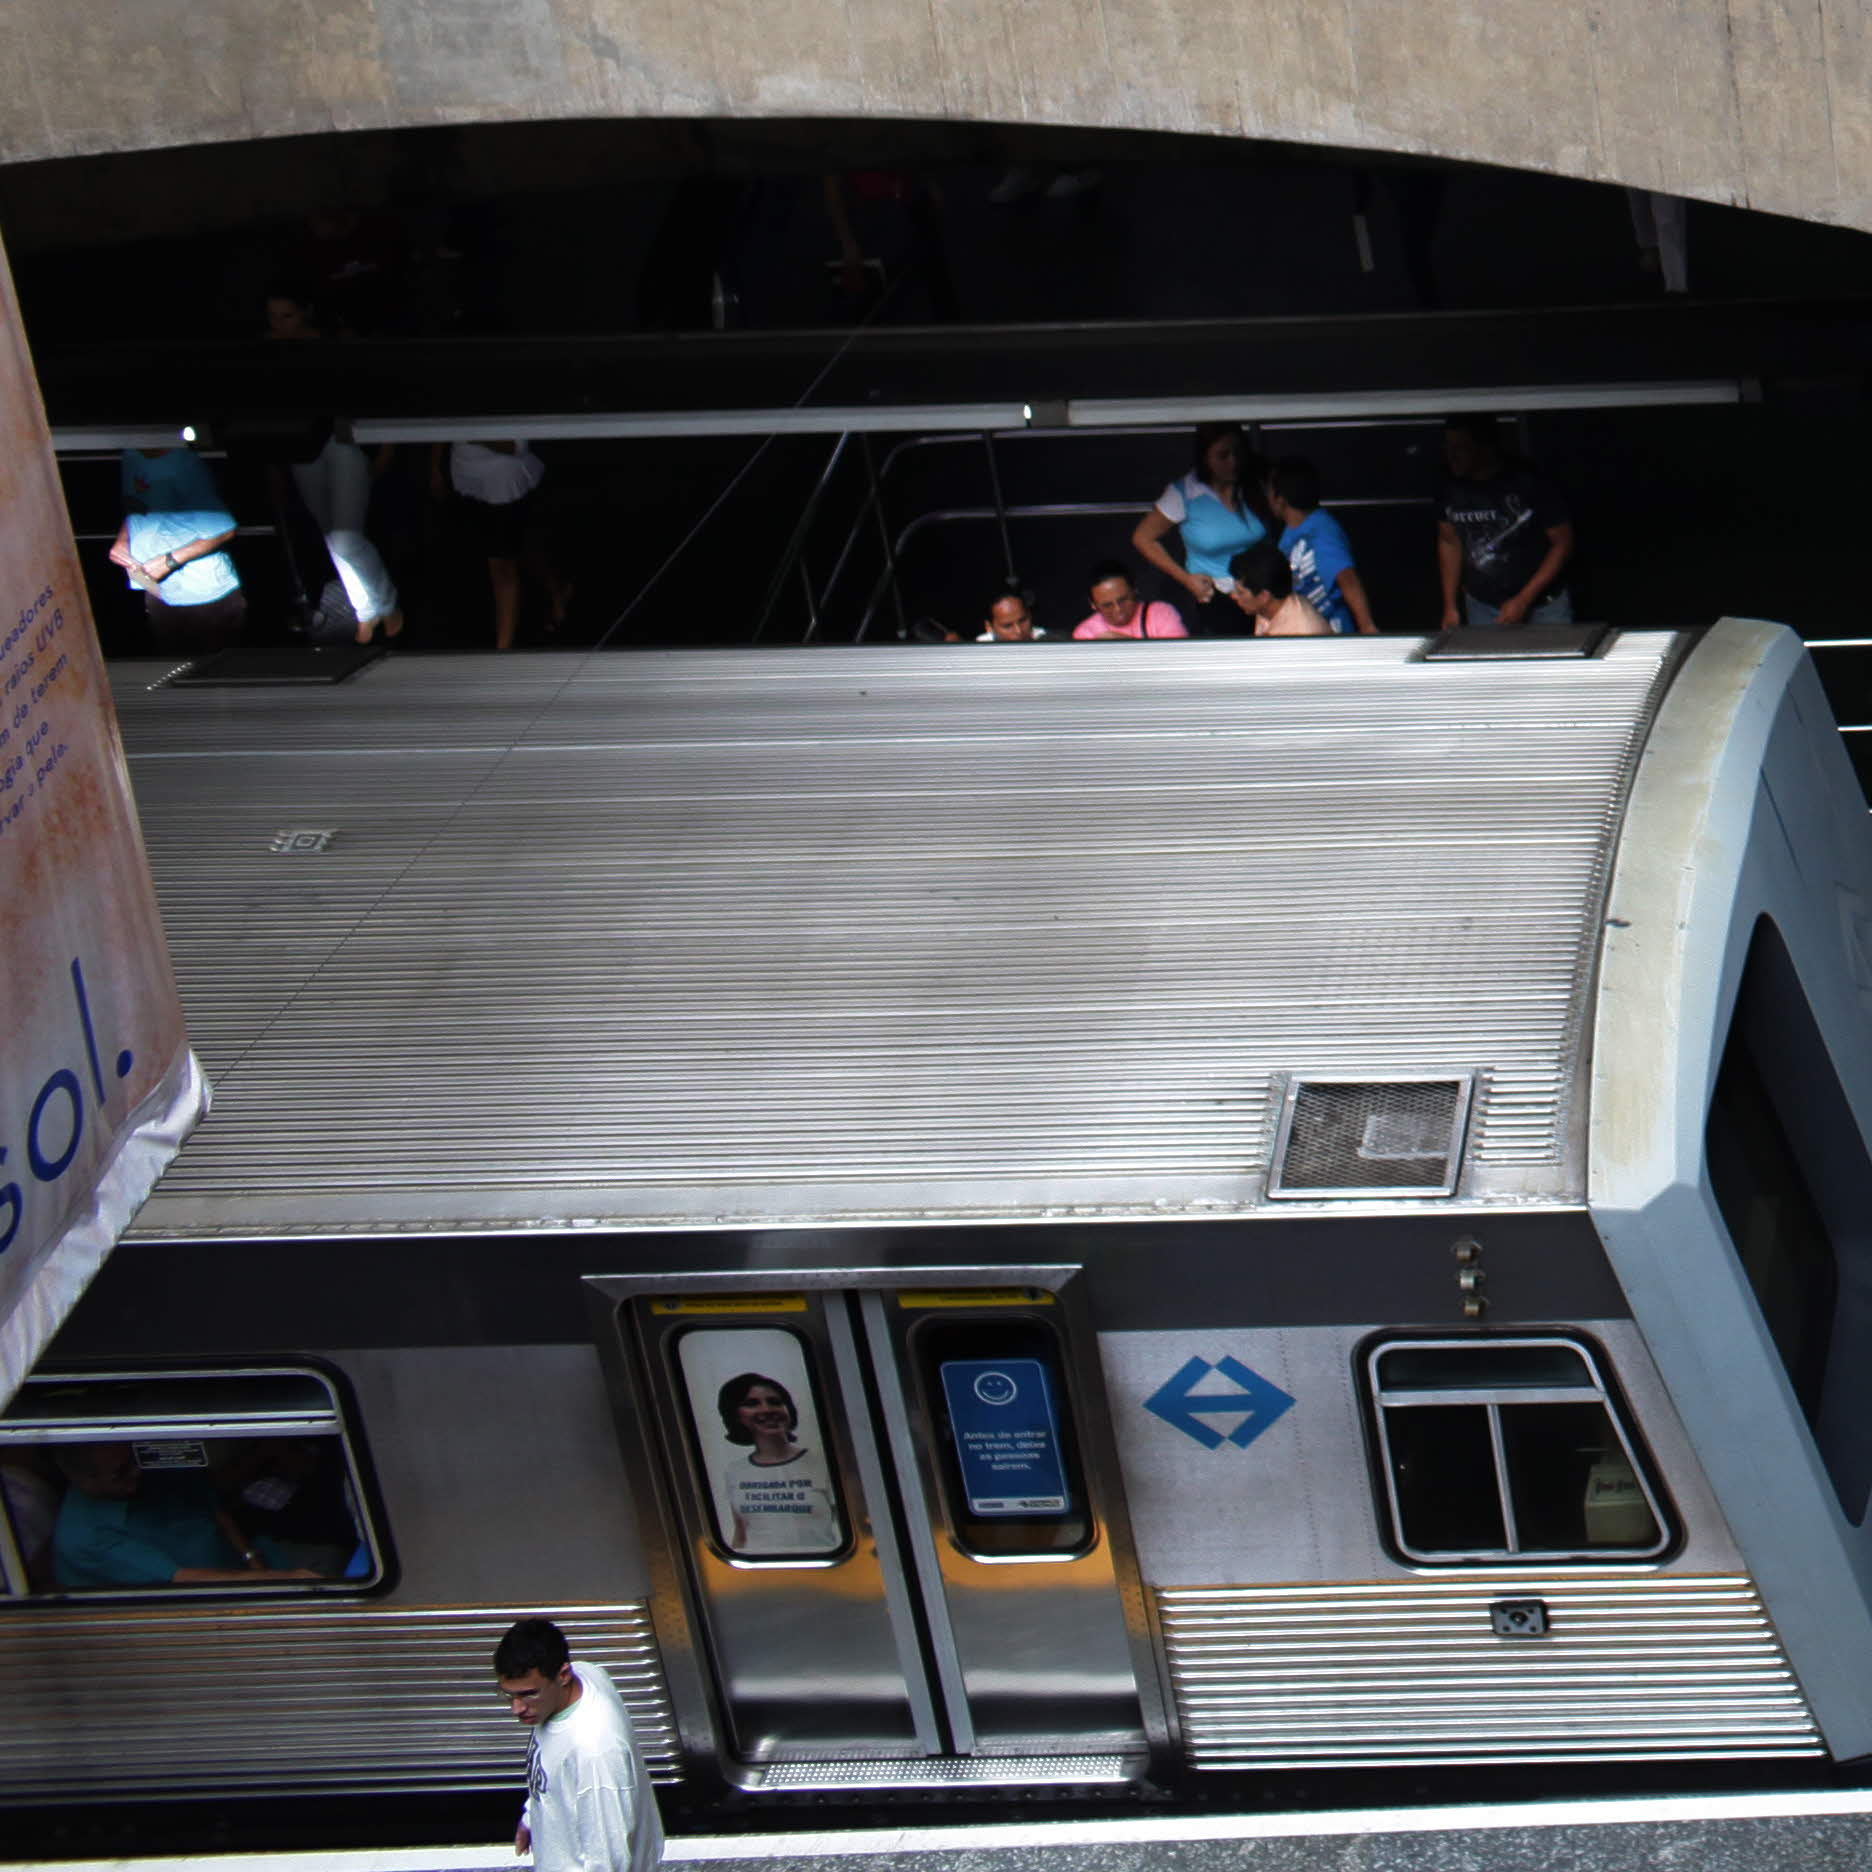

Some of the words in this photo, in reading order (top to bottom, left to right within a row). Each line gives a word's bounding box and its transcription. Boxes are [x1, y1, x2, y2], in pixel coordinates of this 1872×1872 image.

[5, 651, 34, 696] raios
[36, 608, 63, 652] UVB
[15, 704, 28, 728] de
[31, 654, 67, 704] terem
[26, 721, 48, 755] que
